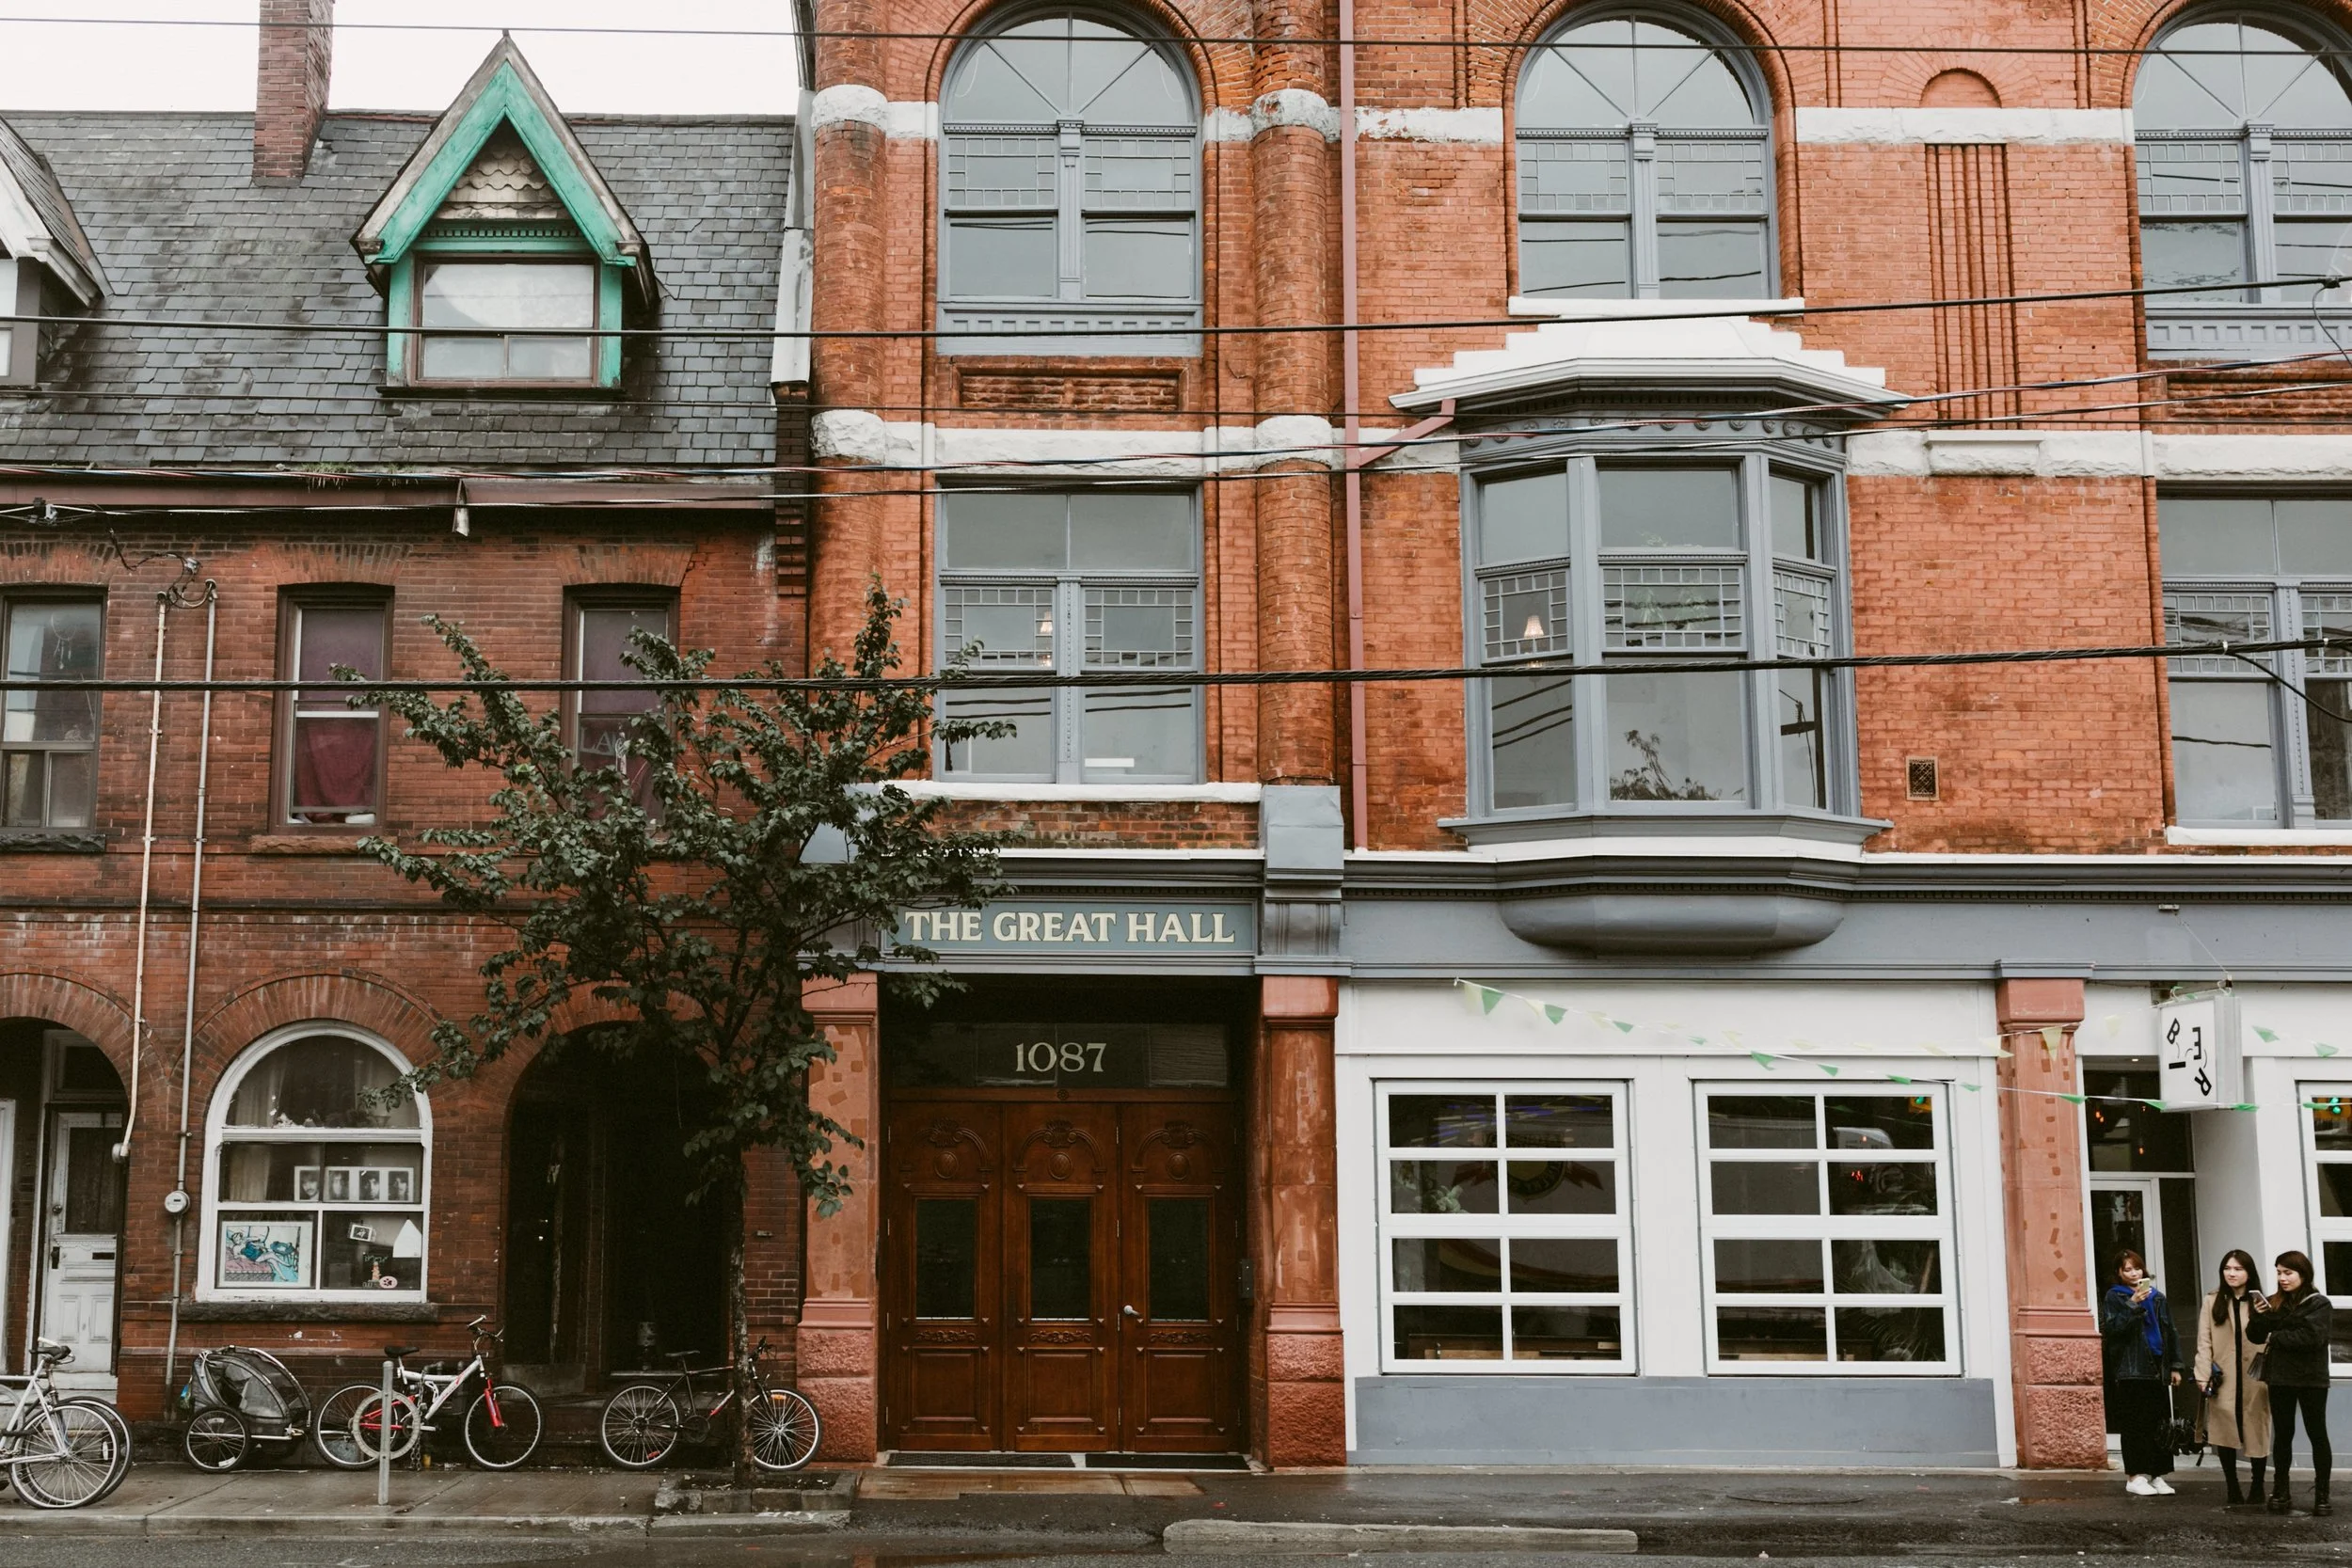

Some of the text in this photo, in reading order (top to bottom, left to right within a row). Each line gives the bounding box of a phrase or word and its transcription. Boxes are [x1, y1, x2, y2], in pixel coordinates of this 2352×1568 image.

[904, 911, 1235, 943] THE GREAT HALL
[1016, 1042, 1106, 1072] 1087
